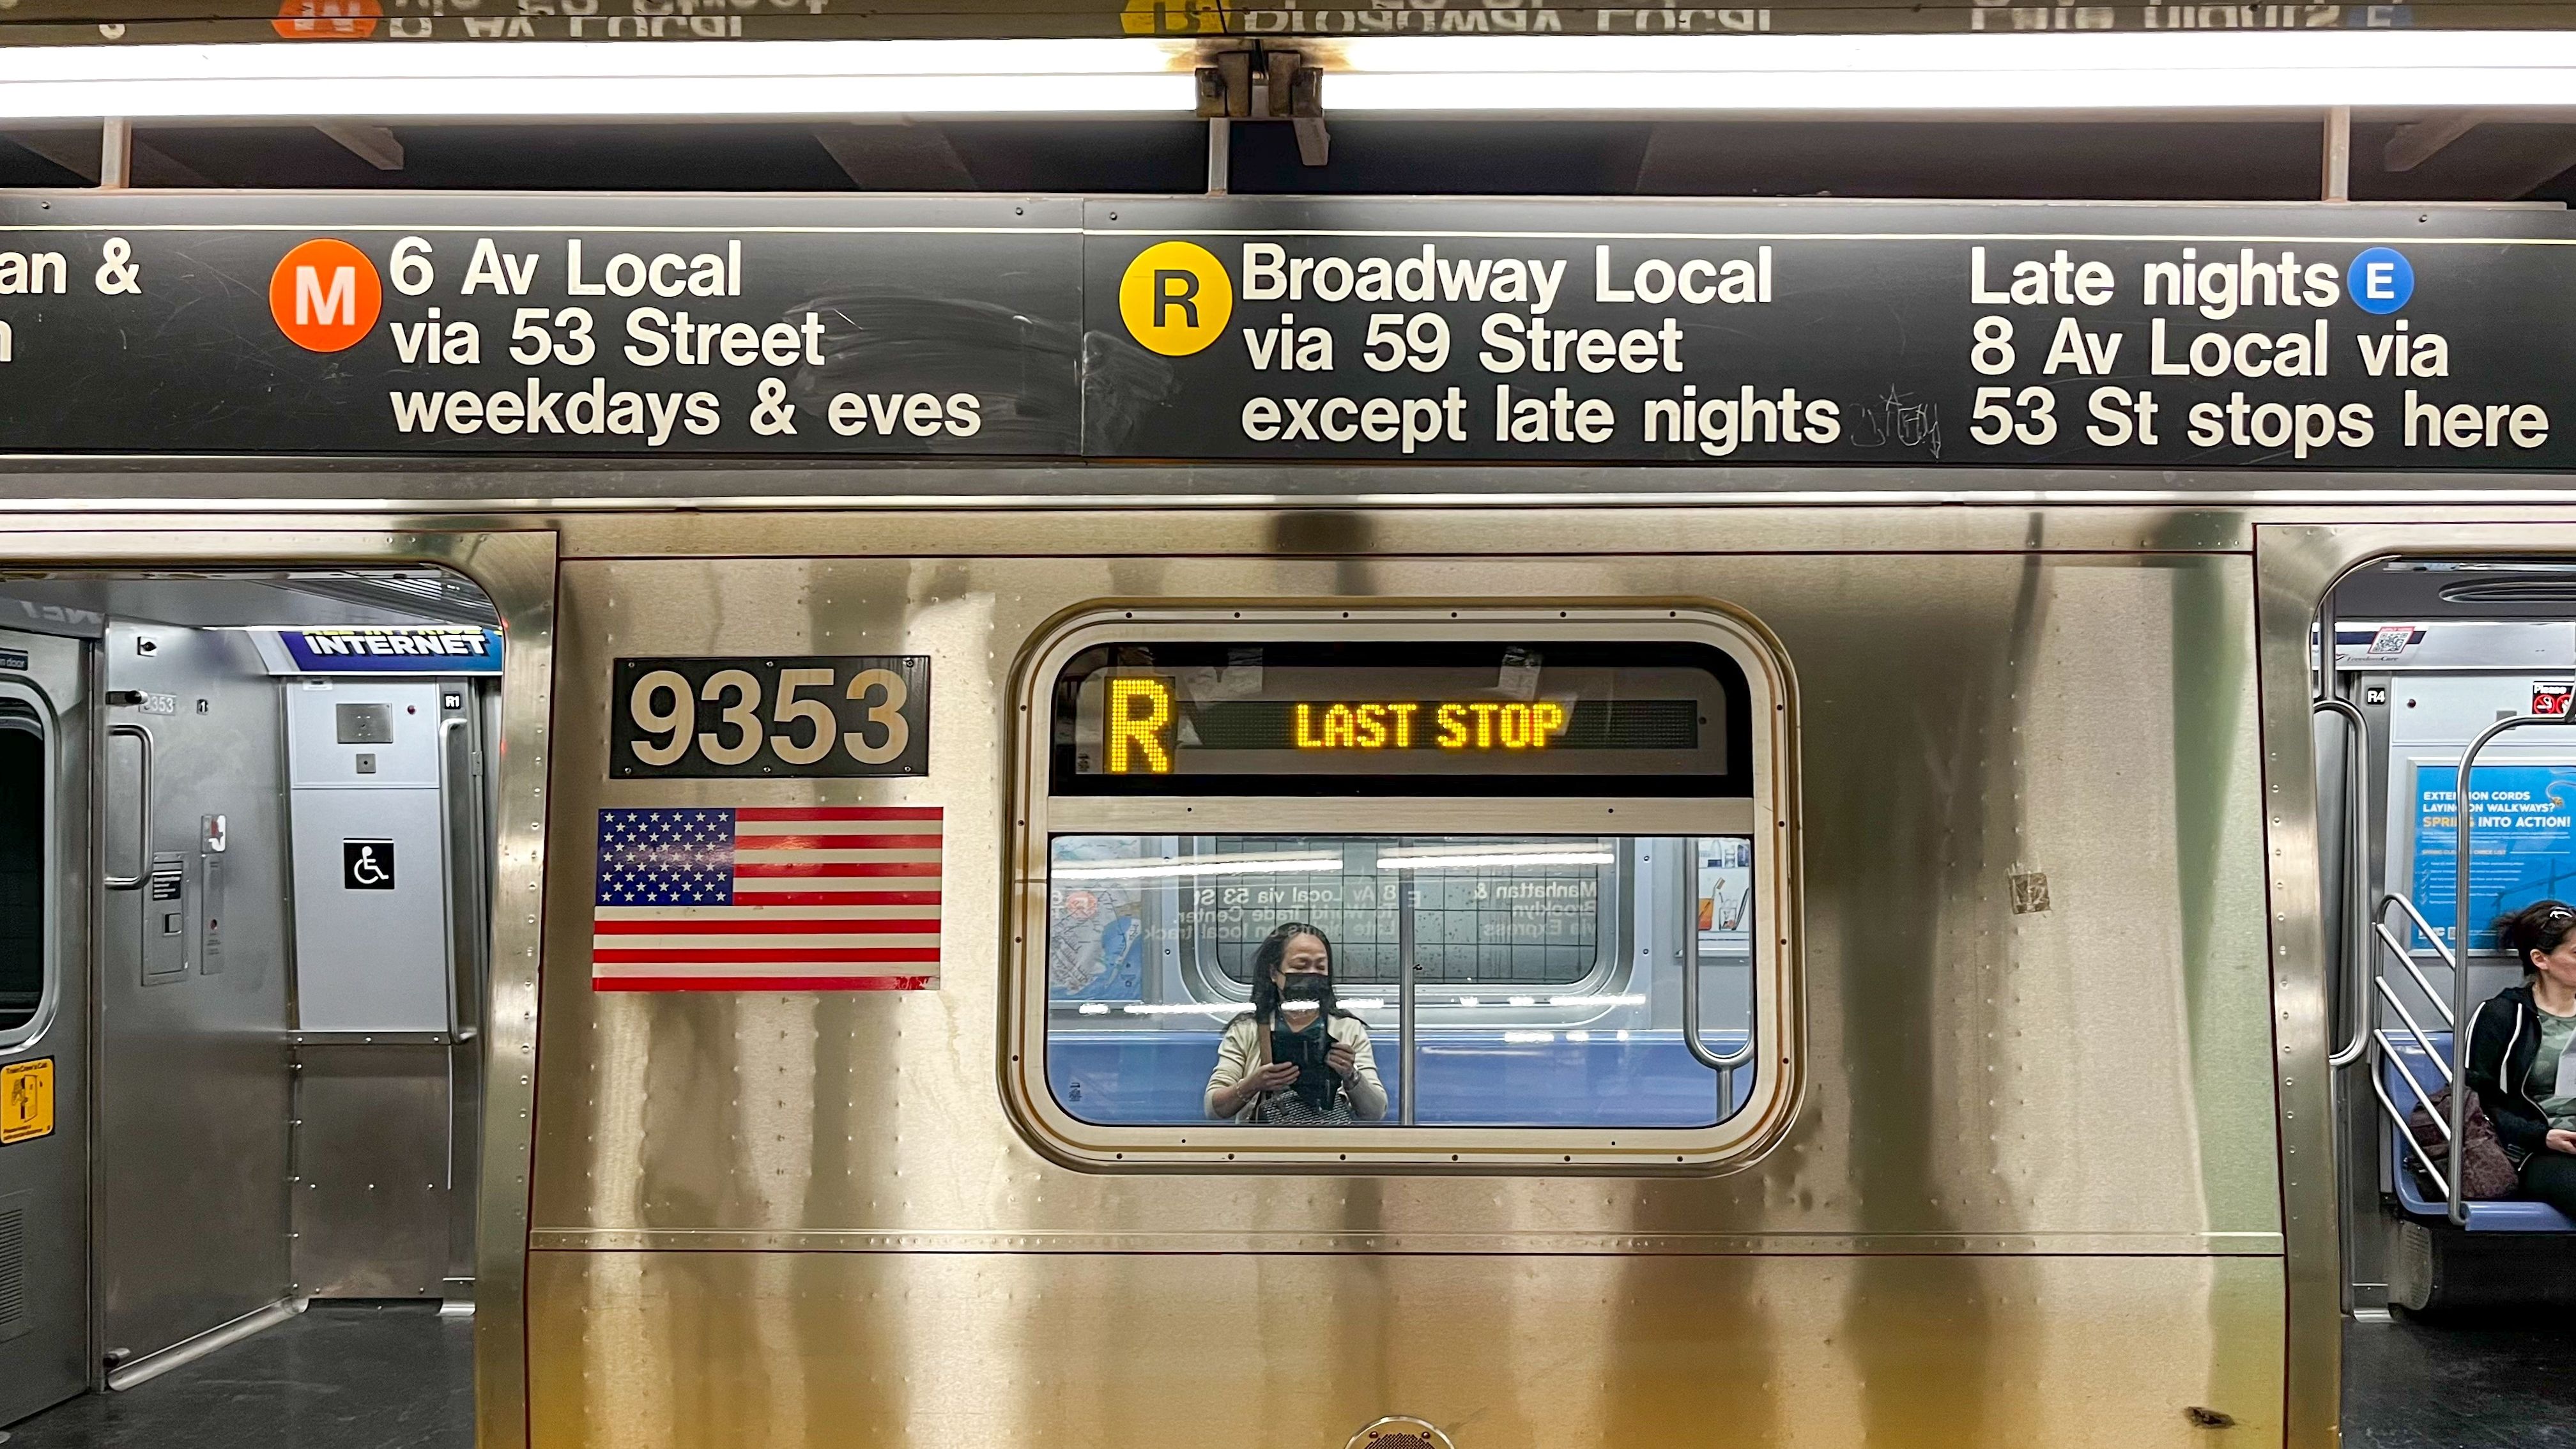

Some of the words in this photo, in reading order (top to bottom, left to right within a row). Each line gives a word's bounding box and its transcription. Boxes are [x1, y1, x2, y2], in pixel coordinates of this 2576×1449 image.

[95, 236, 142, 295] &
[296, 264, 356, 326] M
[389, 236, 434, 296] 6
[461, 238, 540, 295] Av
[567, 238, 742, 298] Local
[1243, 243, 1567, 314] Broadway
[1595, 244, 1772, 304] Local
[1971, 246, 2115, 306] Late
[2143, 247, 2340, 320] nights
[2366, 263, 2395, 299] E
[1153, 269, 1200, 328] R
[389, 307, 480, 365] via
[509, 307, 595, 365] 53
[624, 307, 825, 367] Street
[1243, 313, 1333, 371] via
[1363, 312, 1450, 372] 59
[1479, 312, 1683, 373] Street
[1970, 315, 2016, 375] 8
[2043, 317, 2123, 375] Av
[2151, 318, 2328, 378] Local
[2356, 319, 2449, 378] via
[389, 377, 720, 446] weekdays
[749, 377, 798, 436] &
[828, 392, 981, 437] eves
[1242, 387, 1467, 454] except
[1496, 384, 1614, 443] late
[1644, 385, 1841, 456] nights
[1970, 386, 2057, 445] 53
[2086, 386, 2158, 447] St
[2187, 391, 2374, 459] stops
[2404, 389, 2549, 448] here
[303, 634, 486, 655] INTERNET
[445, 695, 459, 707] R1
[630, 668, 909, 765] 9353
[2367, 690, 2386, 703] R4
[2534, 685, 2567, 694] Please
[1111, 679, 1169, 772] R
[1297, 703, 1416, 747] LAST
[1438, 703, 1562, 747] STOP
[2423, 792, 2488, 801] EXTEION
[2491, 792, 2531, 801] CORDS
[2478, 816, 2512, 827] INTO
[2515, 816, 2571, 827] ACTION!
[2487, 802, 2555, 813] WALKWAYS?
